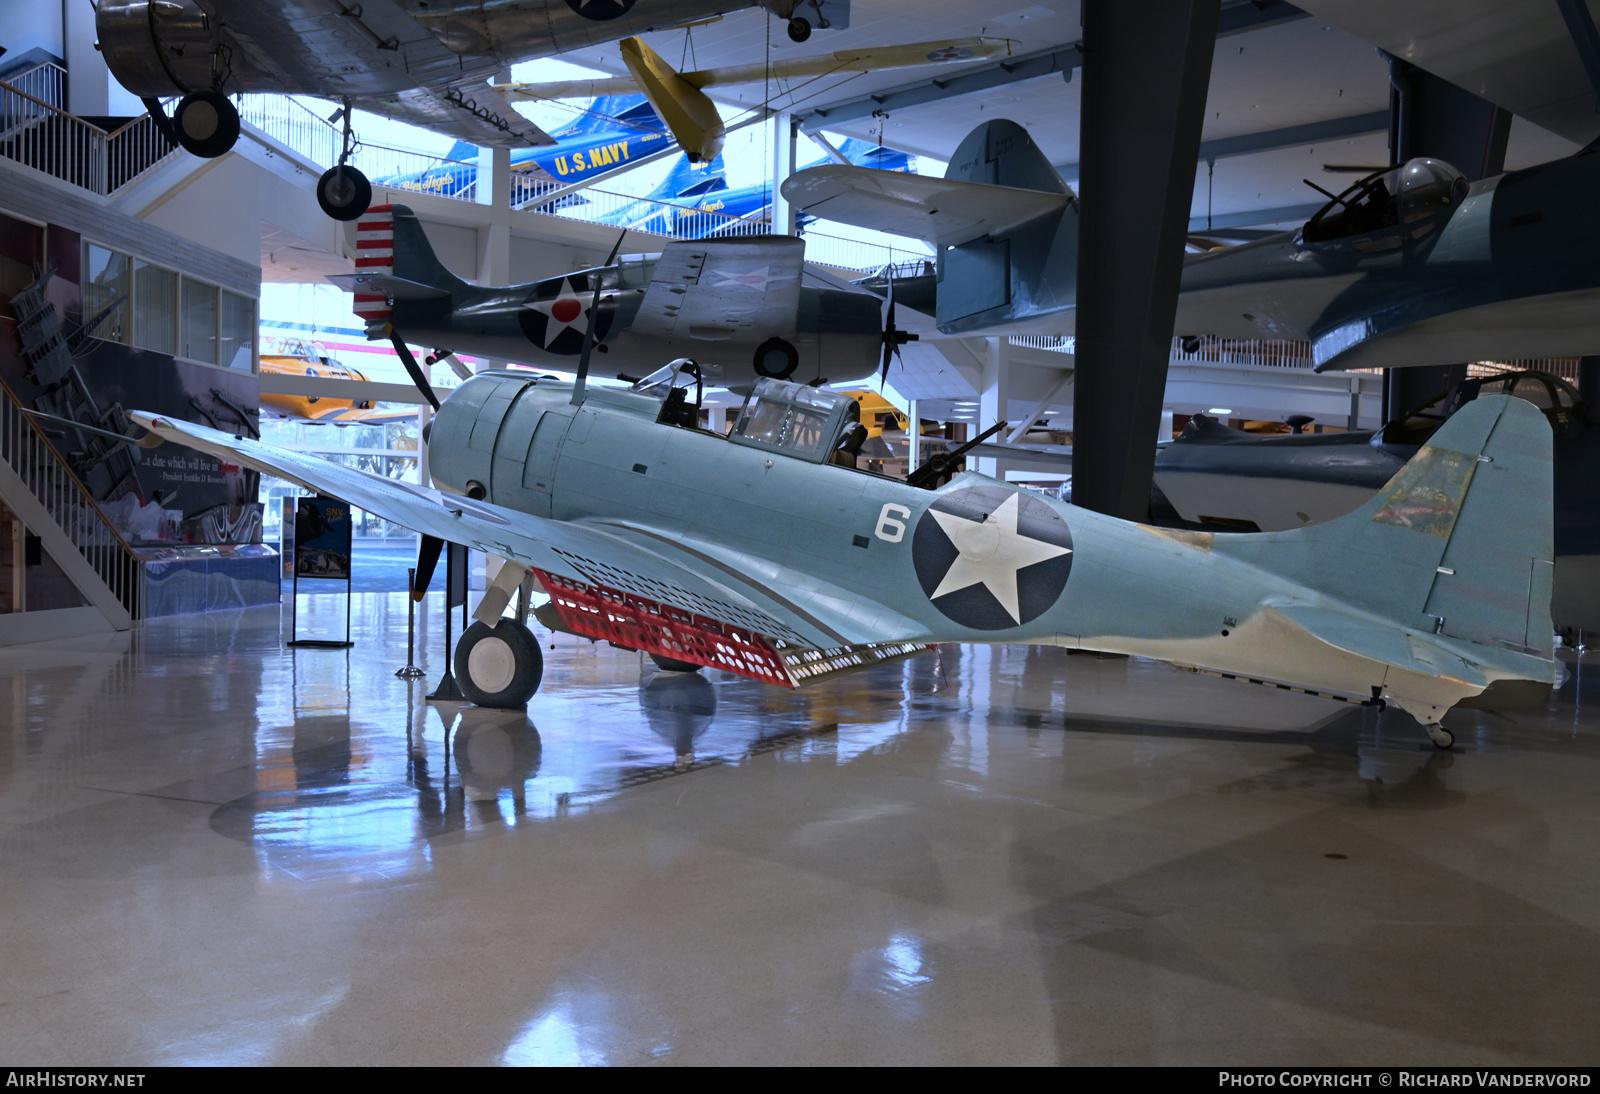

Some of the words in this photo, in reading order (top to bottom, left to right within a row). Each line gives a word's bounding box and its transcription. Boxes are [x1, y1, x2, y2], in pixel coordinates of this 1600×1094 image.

[152, 454, 166, 467] date
[168, 456, 186, 469] which
[188, 457, 199, 470] will
[200, 459, 211, 471] live
[212, 461, 219, 472] in
[163, 471, 183, 481] President
[183, 473, 201, 482] Franklin
[875, 502, 911, 543] 6
